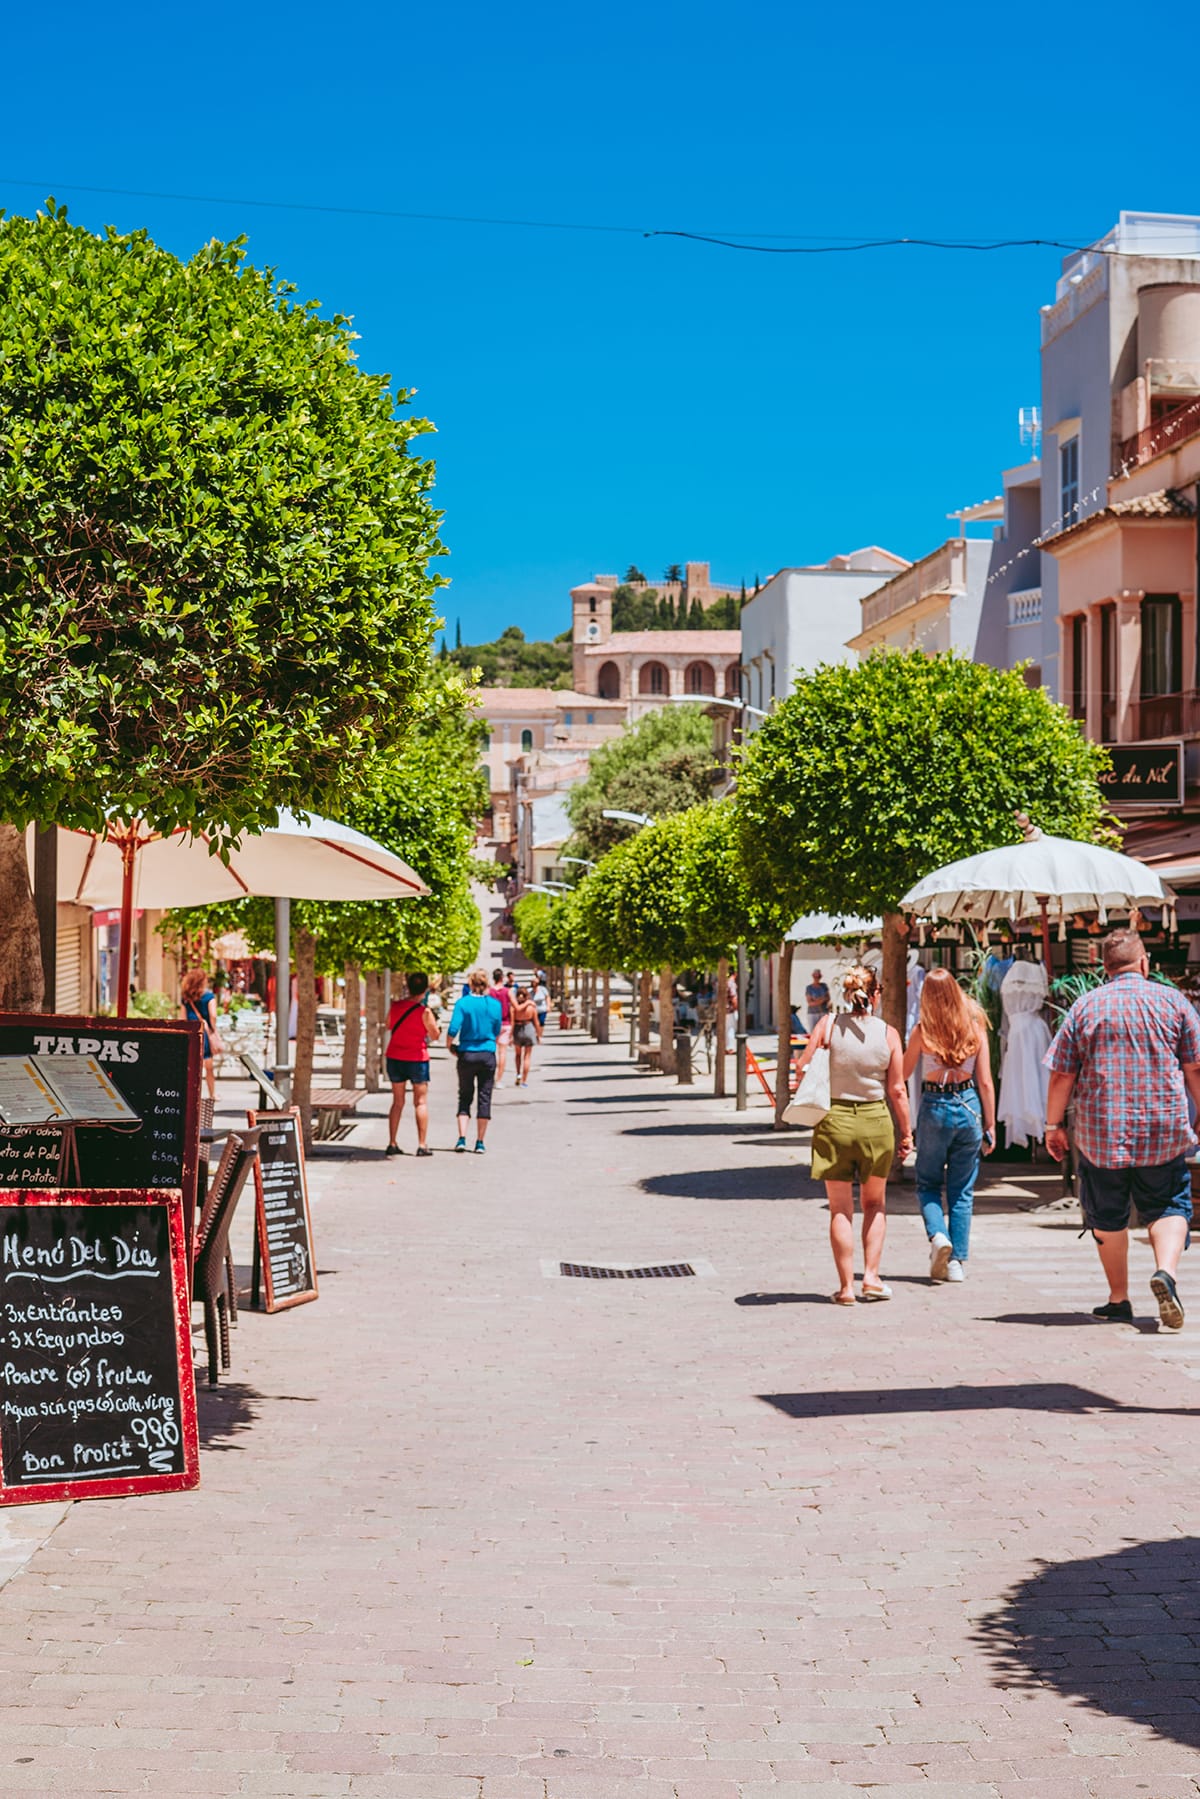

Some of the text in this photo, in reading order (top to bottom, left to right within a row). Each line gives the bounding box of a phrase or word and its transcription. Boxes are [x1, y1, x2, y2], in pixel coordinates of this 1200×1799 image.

[1097, 771, 1119, 785] nc
[1121, 763, 1142, 785] du
[33, 1035, 140, 1063] TAPAS
[69, 1236, 106, 1267] Del
[4, 1400, 38, 1423] Agua
[22, 1450, 65, 1472] Bon
